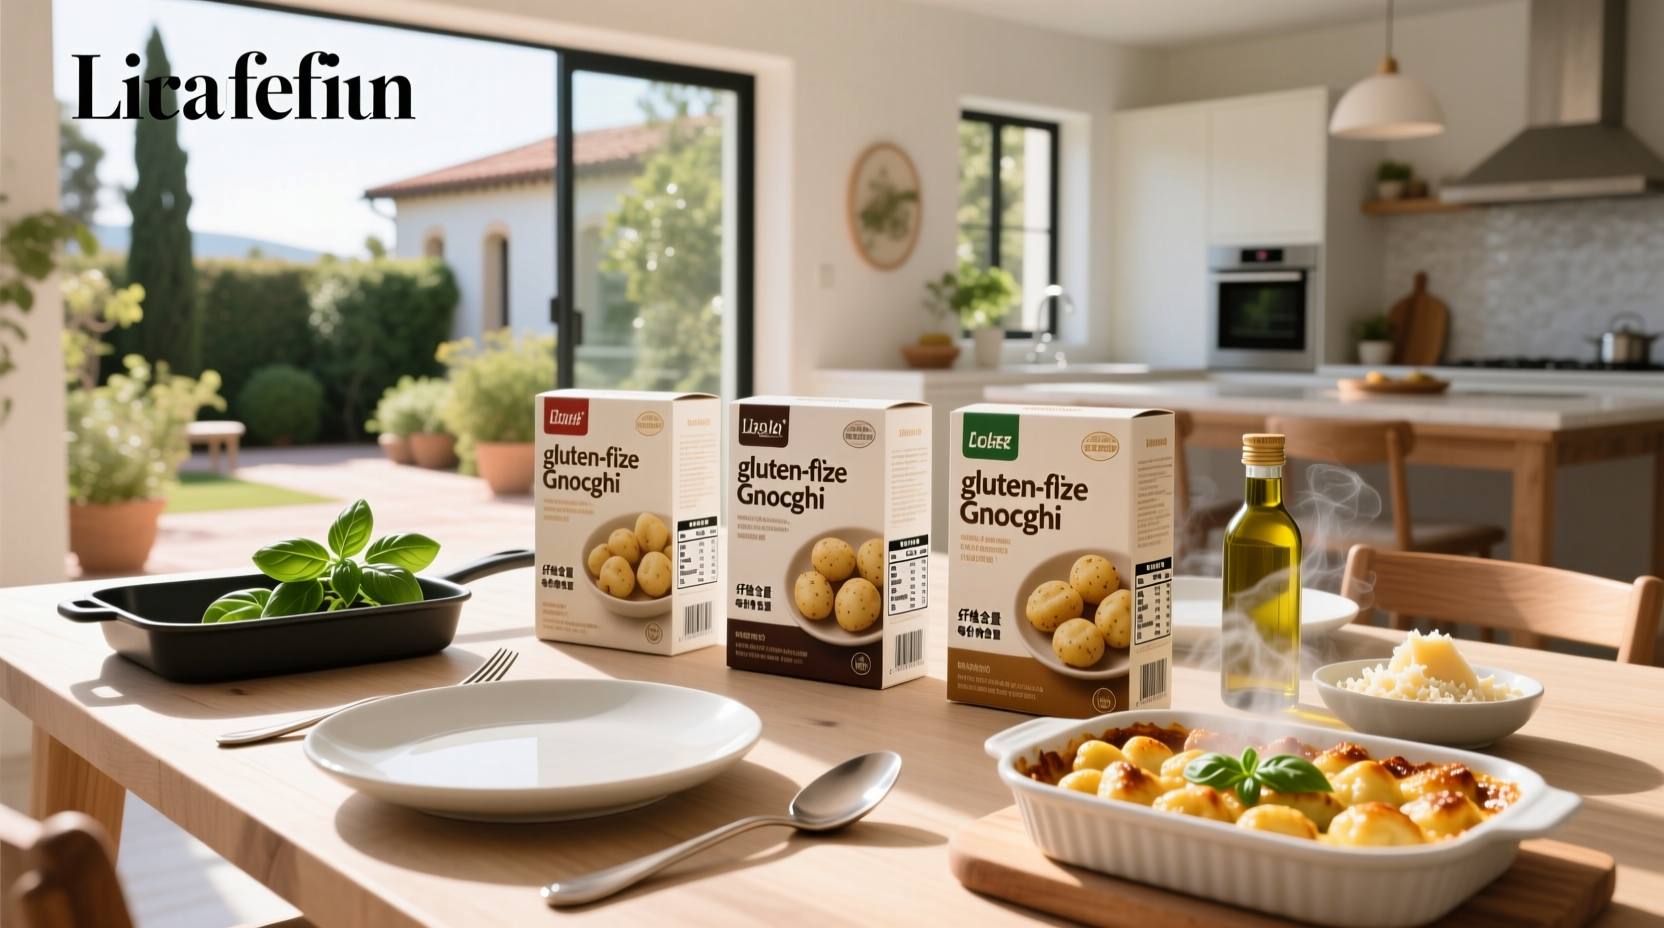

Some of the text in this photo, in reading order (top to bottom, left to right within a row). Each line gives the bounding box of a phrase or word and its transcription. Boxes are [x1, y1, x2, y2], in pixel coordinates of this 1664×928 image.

[542, 468, 621, 499] Gnocghi
[736, 483, 825, 515] Gnocghi
[959, 500, 1062, 536] Gnocghi
